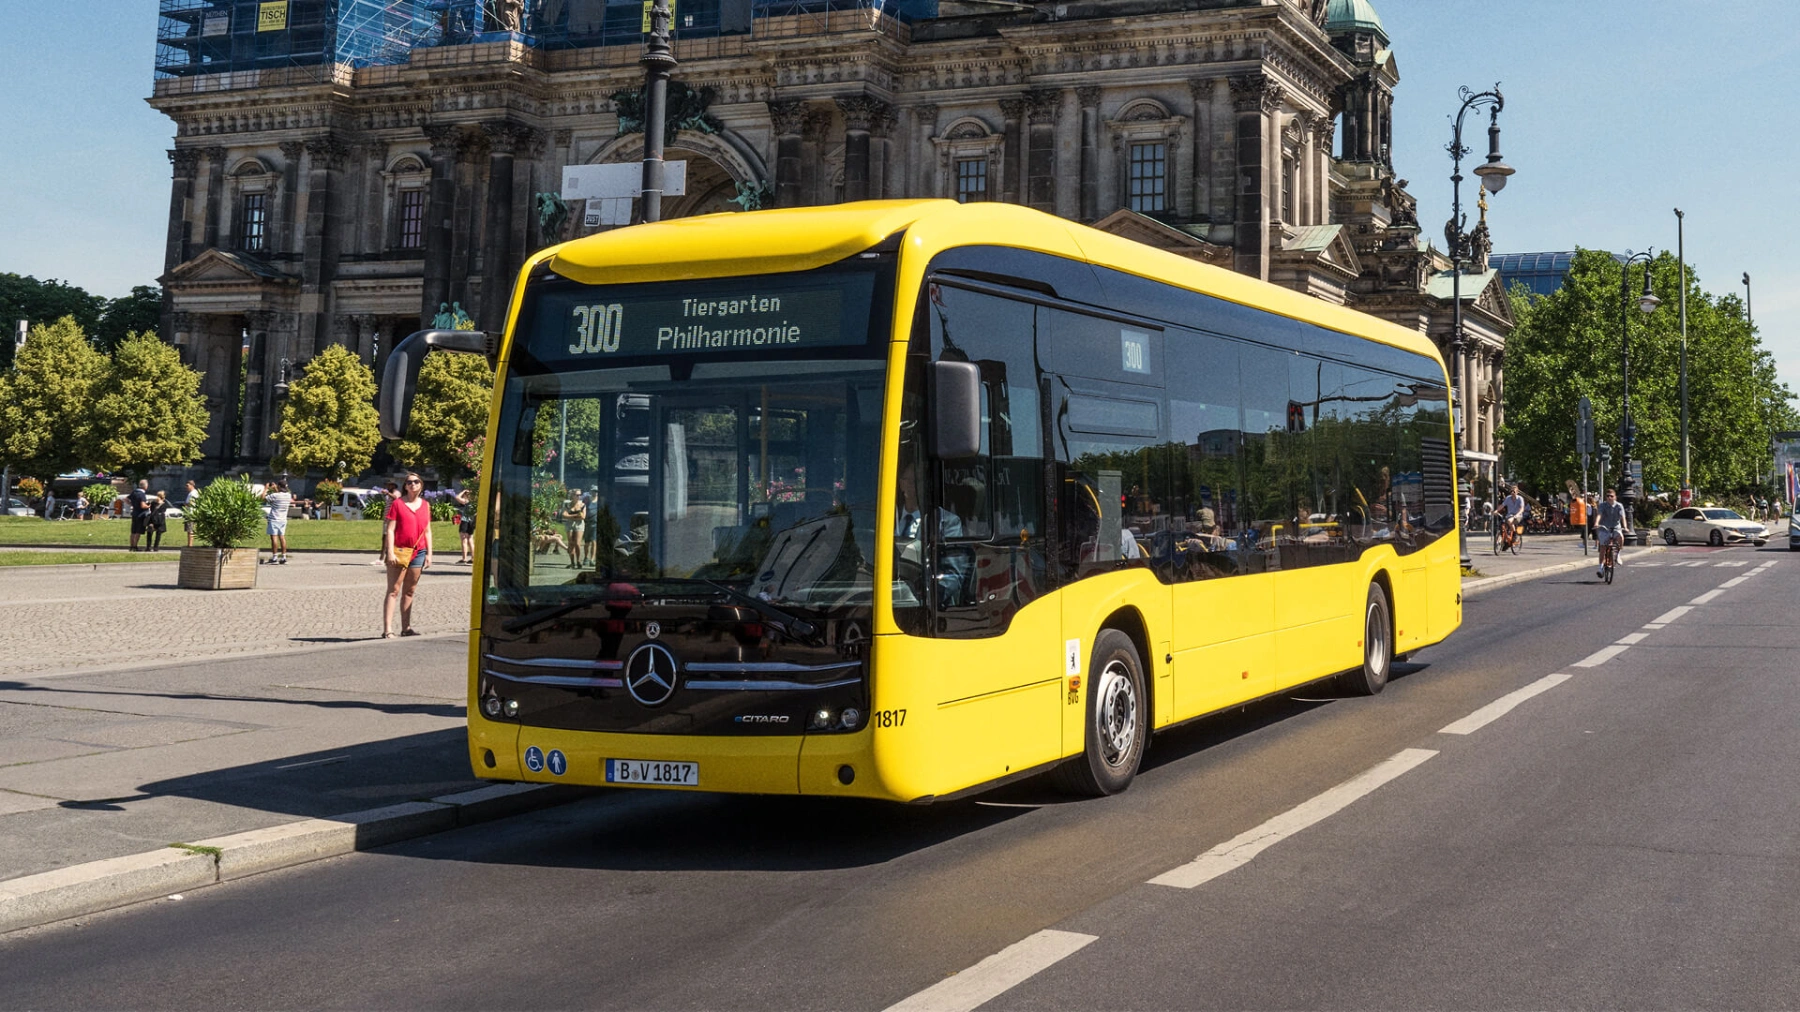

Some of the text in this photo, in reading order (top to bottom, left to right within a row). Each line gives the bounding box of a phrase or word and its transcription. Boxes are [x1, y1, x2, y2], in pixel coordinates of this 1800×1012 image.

[260, 10, 286, 20] TISCH
[683, 295, 781, 318] Tiergarten
[569, 303, 623, 355] 300
[657, 321, 801, 350] Philharmonie
[1124, 341, 1142, 370] 300
[734, 714, 790, 724] eCITARO
[874, 710, 907, 728] 1817
[620, 762, 692, 783] B V 1817
